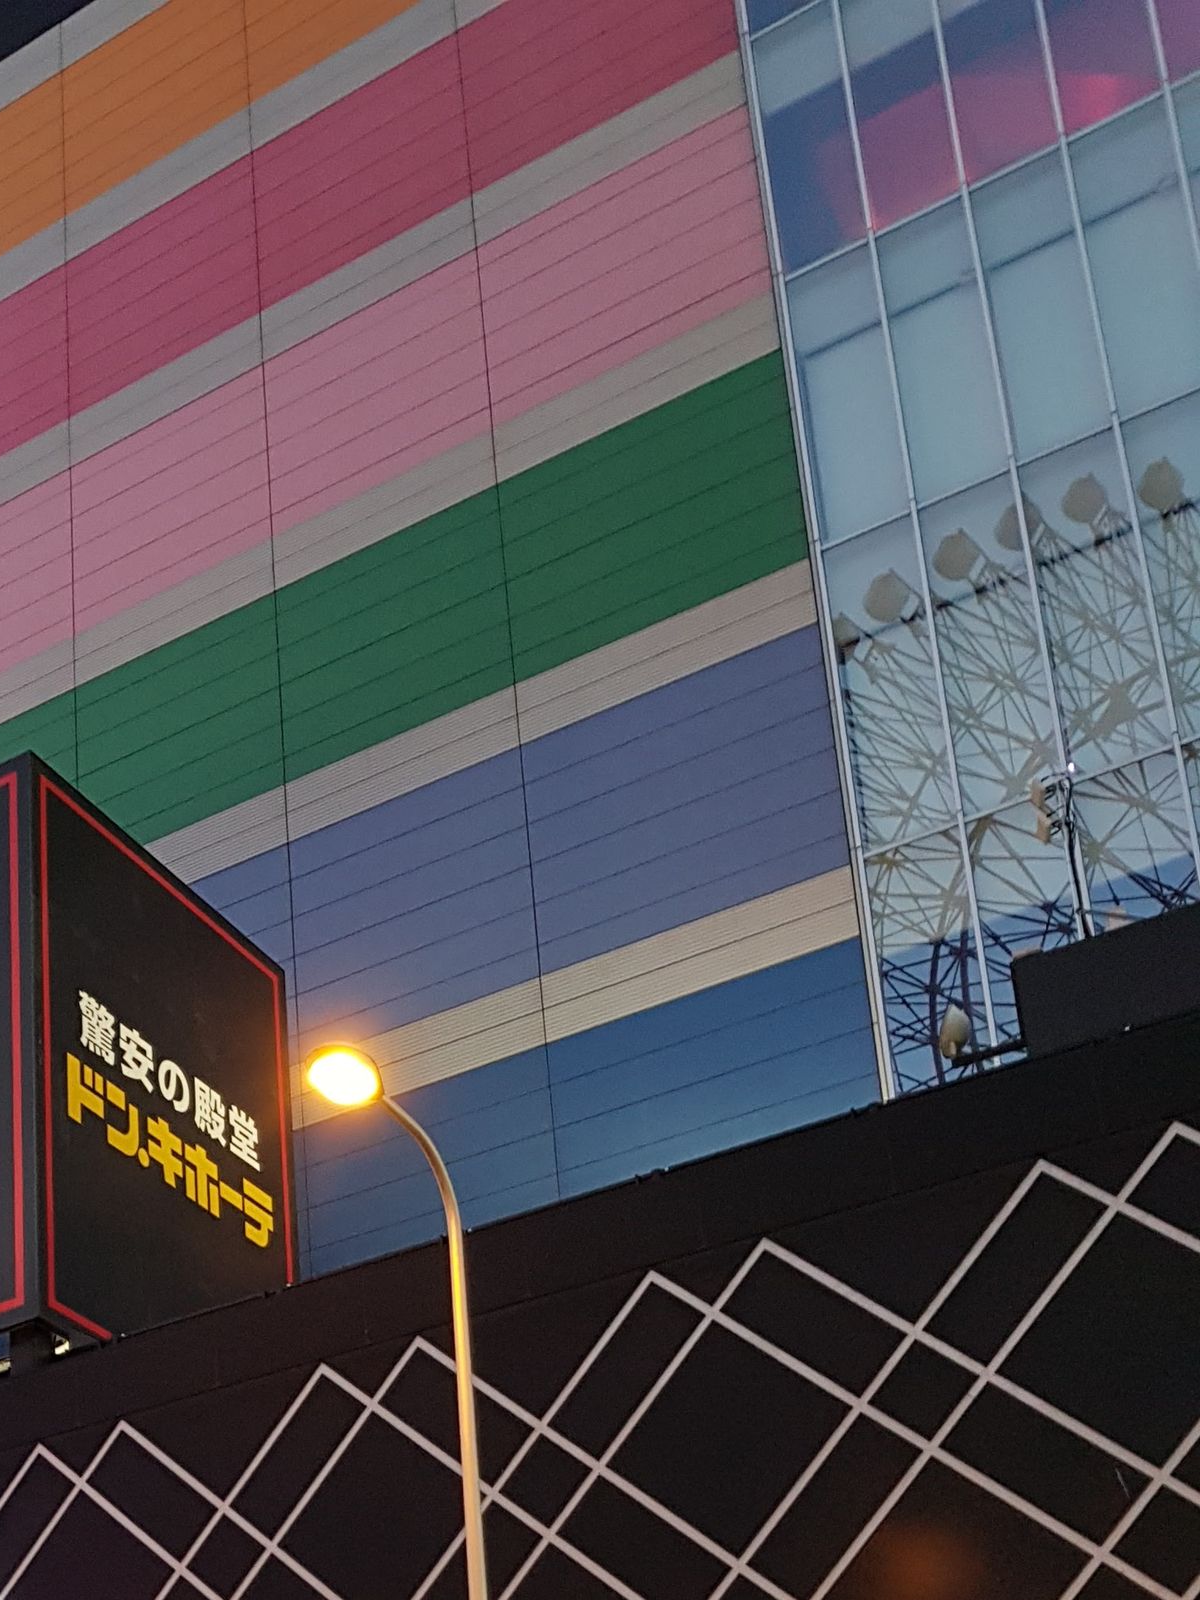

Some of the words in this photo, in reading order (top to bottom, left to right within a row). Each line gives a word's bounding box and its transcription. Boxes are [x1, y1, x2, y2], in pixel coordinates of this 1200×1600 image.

[78, 989, 261, 1173] 驚安の殿堂
